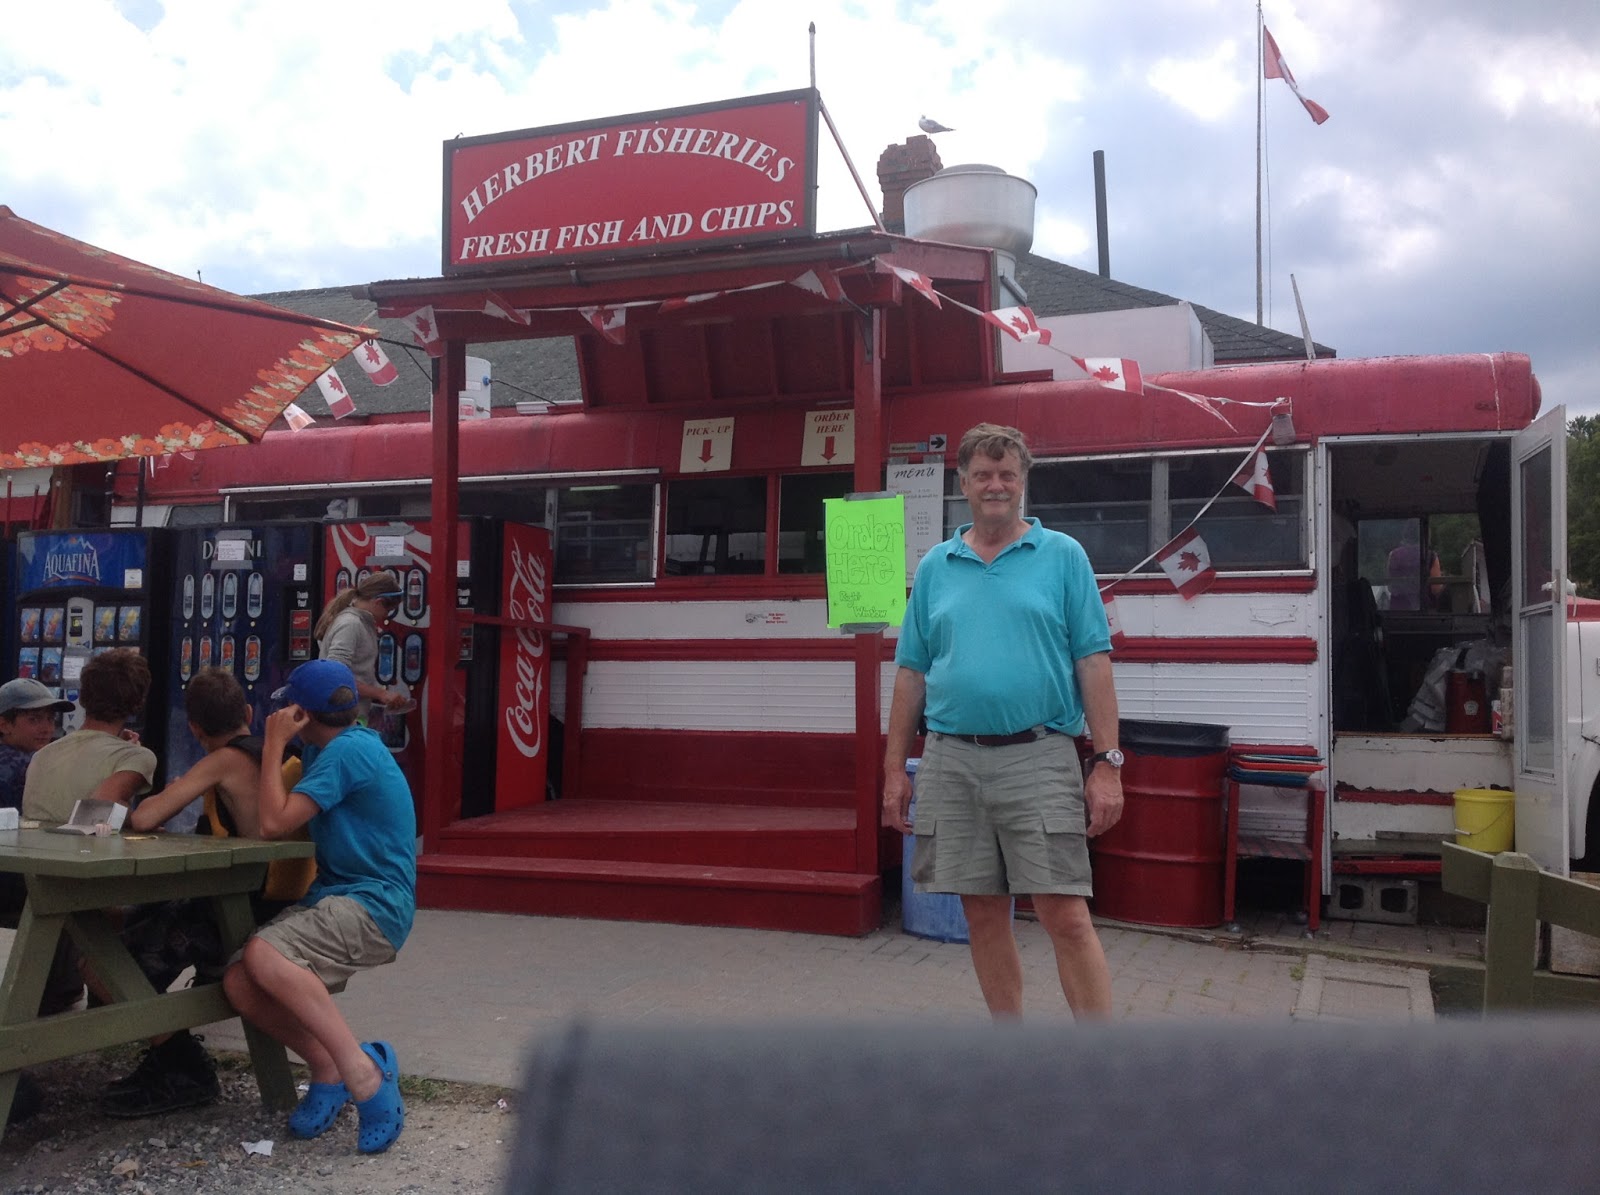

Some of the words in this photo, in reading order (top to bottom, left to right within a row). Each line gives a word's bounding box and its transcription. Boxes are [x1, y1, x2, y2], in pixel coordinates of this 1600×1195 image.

[460, 133, 608, 224] HERBERT
[613, 127, 796, 182] FISHERIES
[459, 228, 551, 260] FRESH
[555, 219, 624, 249] FISH
[627, 212, 693, 242] AND
[700, 199, 794, 233] CHIPS
[813, 412, 850, 423] ORDER
[816, 424, 846, 434] HERE
[827, 513, 904, 553] Order
[43, 549, 101, 581] AQUAFINA
[202, 540, 262, 560] DNI
[828, 552, 895, 586] Here
[852, 605, 888, 619] Window
